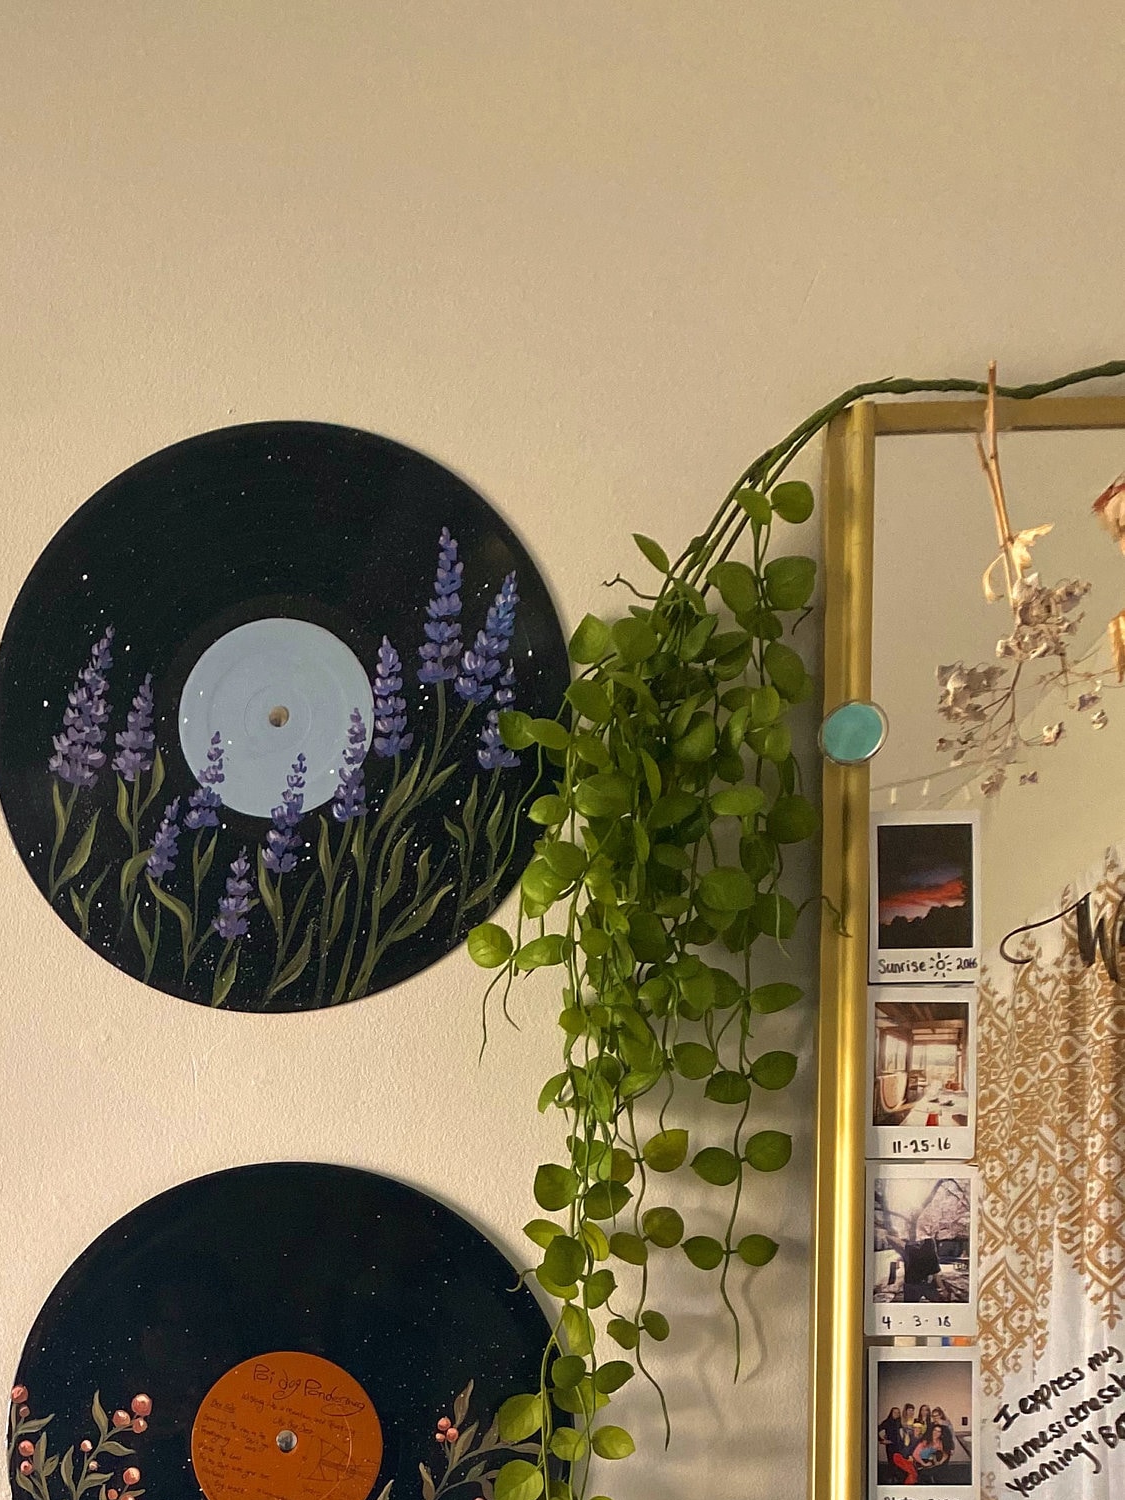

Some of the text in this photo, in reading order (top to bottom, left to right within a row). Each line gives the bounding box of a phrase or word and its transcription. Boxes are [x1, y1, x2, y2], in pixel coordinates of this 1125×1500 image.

[878, 958, 926, 974] Sunrise
[1018, 1367, 1085, 1410] express
[1087, 1345, 1124, 1372] my
